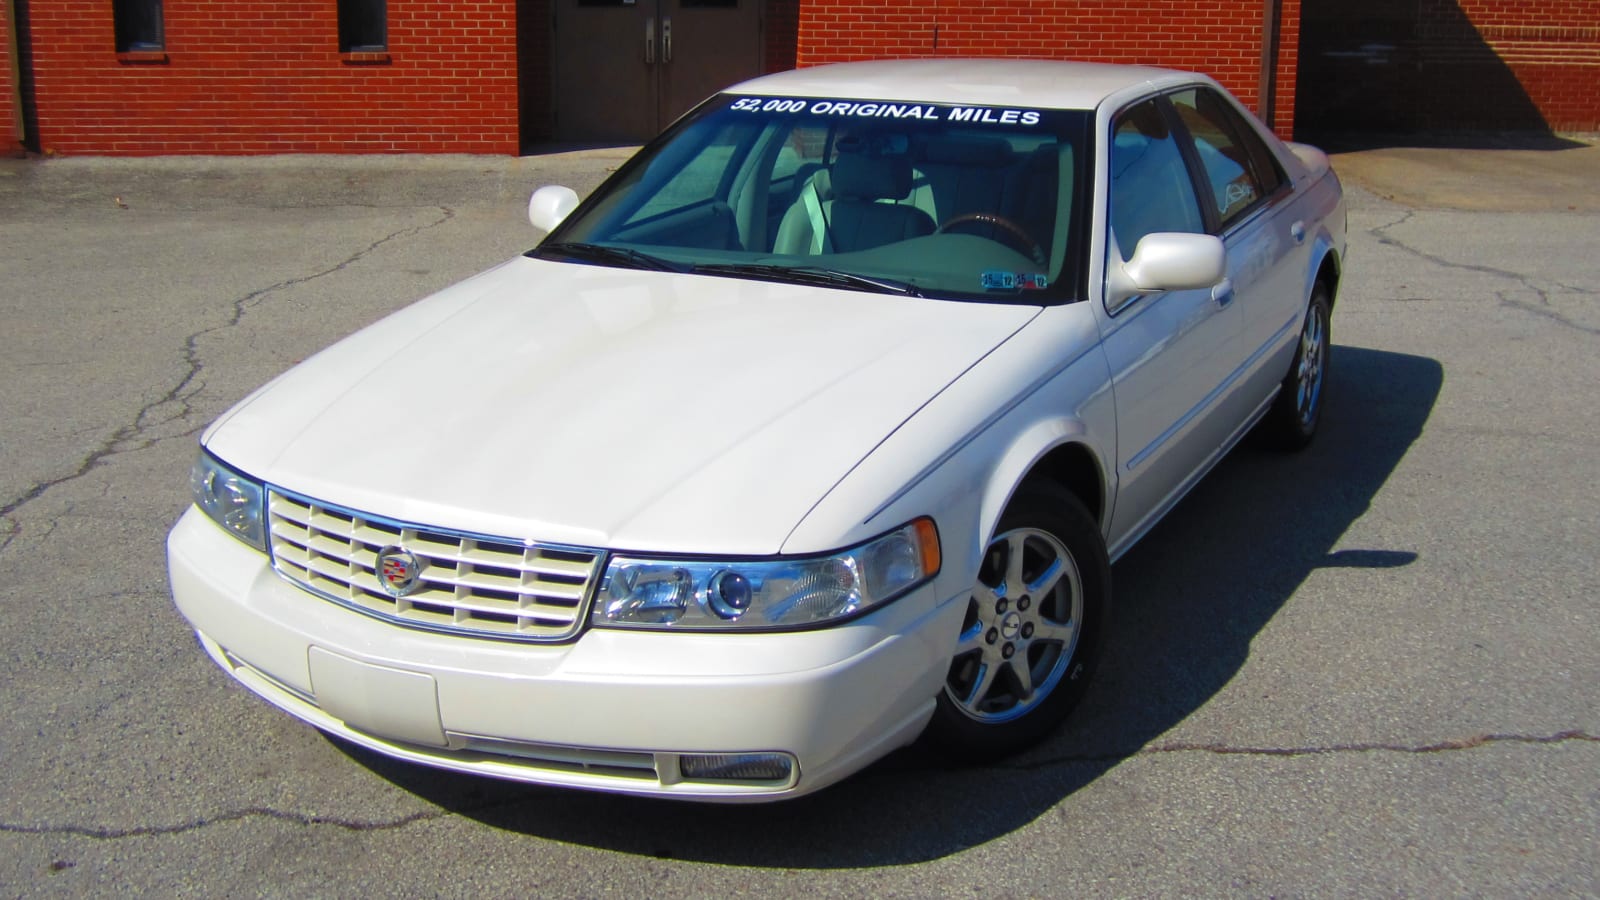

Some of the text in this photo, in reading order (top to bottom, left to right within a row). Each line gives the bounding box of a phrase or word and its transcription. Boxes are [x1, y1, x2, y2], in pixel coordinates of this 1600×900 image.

[730, 98, 1041, 125] 52,000 ORIGINAL MILES
